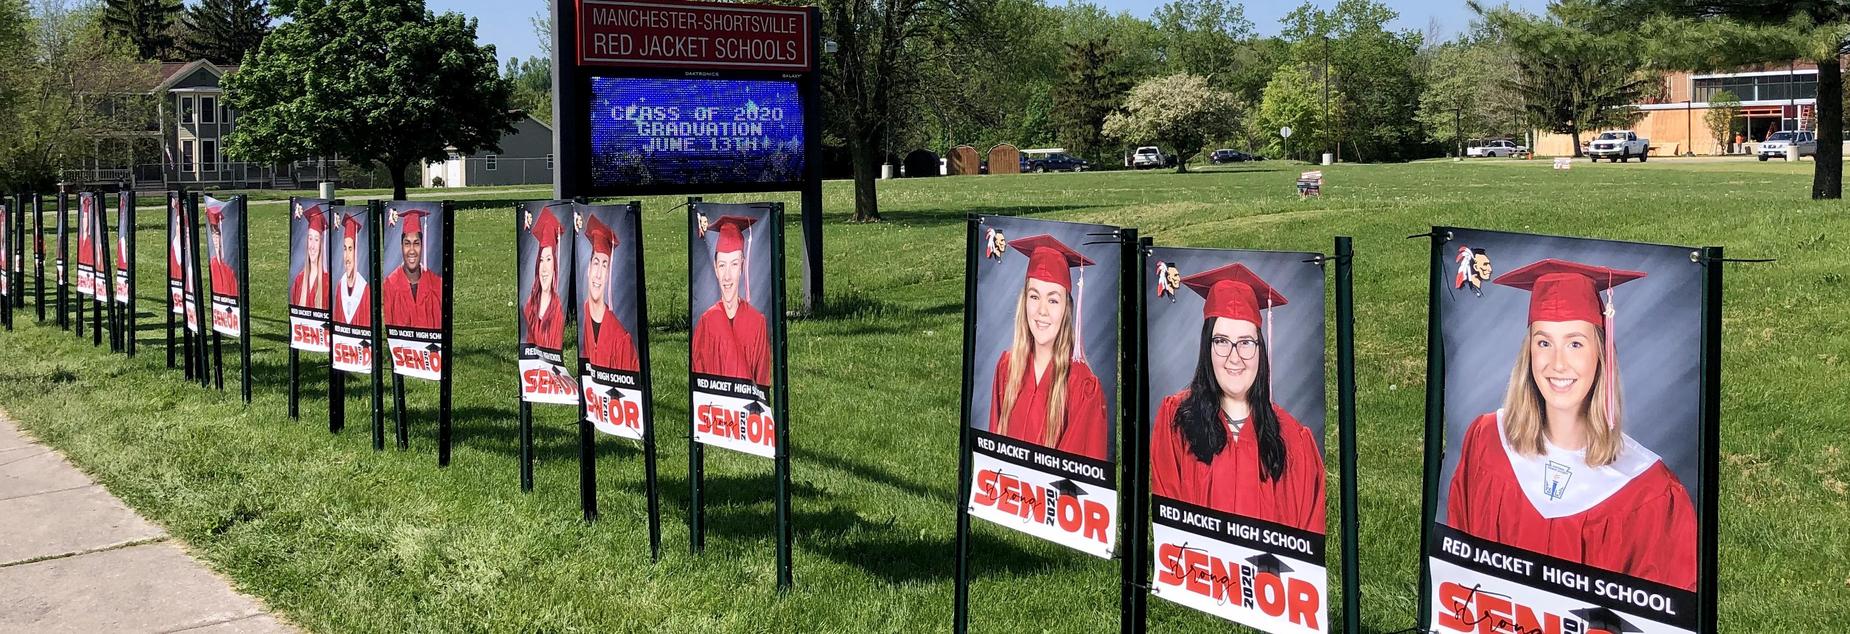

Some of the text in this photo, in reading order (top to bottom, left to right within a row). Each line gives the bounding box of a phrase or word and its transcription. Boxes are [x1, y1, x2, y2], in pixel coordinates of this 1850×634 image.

[593, 8, 797, 34] MANCHESTER-SHORTSVILLE
[594, 33, 797, 60] RED JACKET SCHOOLS
[611, 106, 784, 121] CLASS OF 2020
[637, 122, 763, 136] GRADUATION
[643, 137, 696, 152] JUNE
[610, 373, 635, 385] SCHOOL
[697, 378, 709, 388] RED
[709, 380, 732, 392] JACKET
[734, 383, 752, 394] HIGH
[977, 436, 1106, 480] RED JACKET HIGH SCHOOL
[1046, 488, 1056, 527] 2020
[1159, 504, 1314, 555] RED JACKET HIGH SCHOOL
[1241, 564, 1254, 610] 2020
[1442, 536, 1676, 615] RED JACKET HIGH SCHOOL
[1454, 583, 1543, 634] stron
